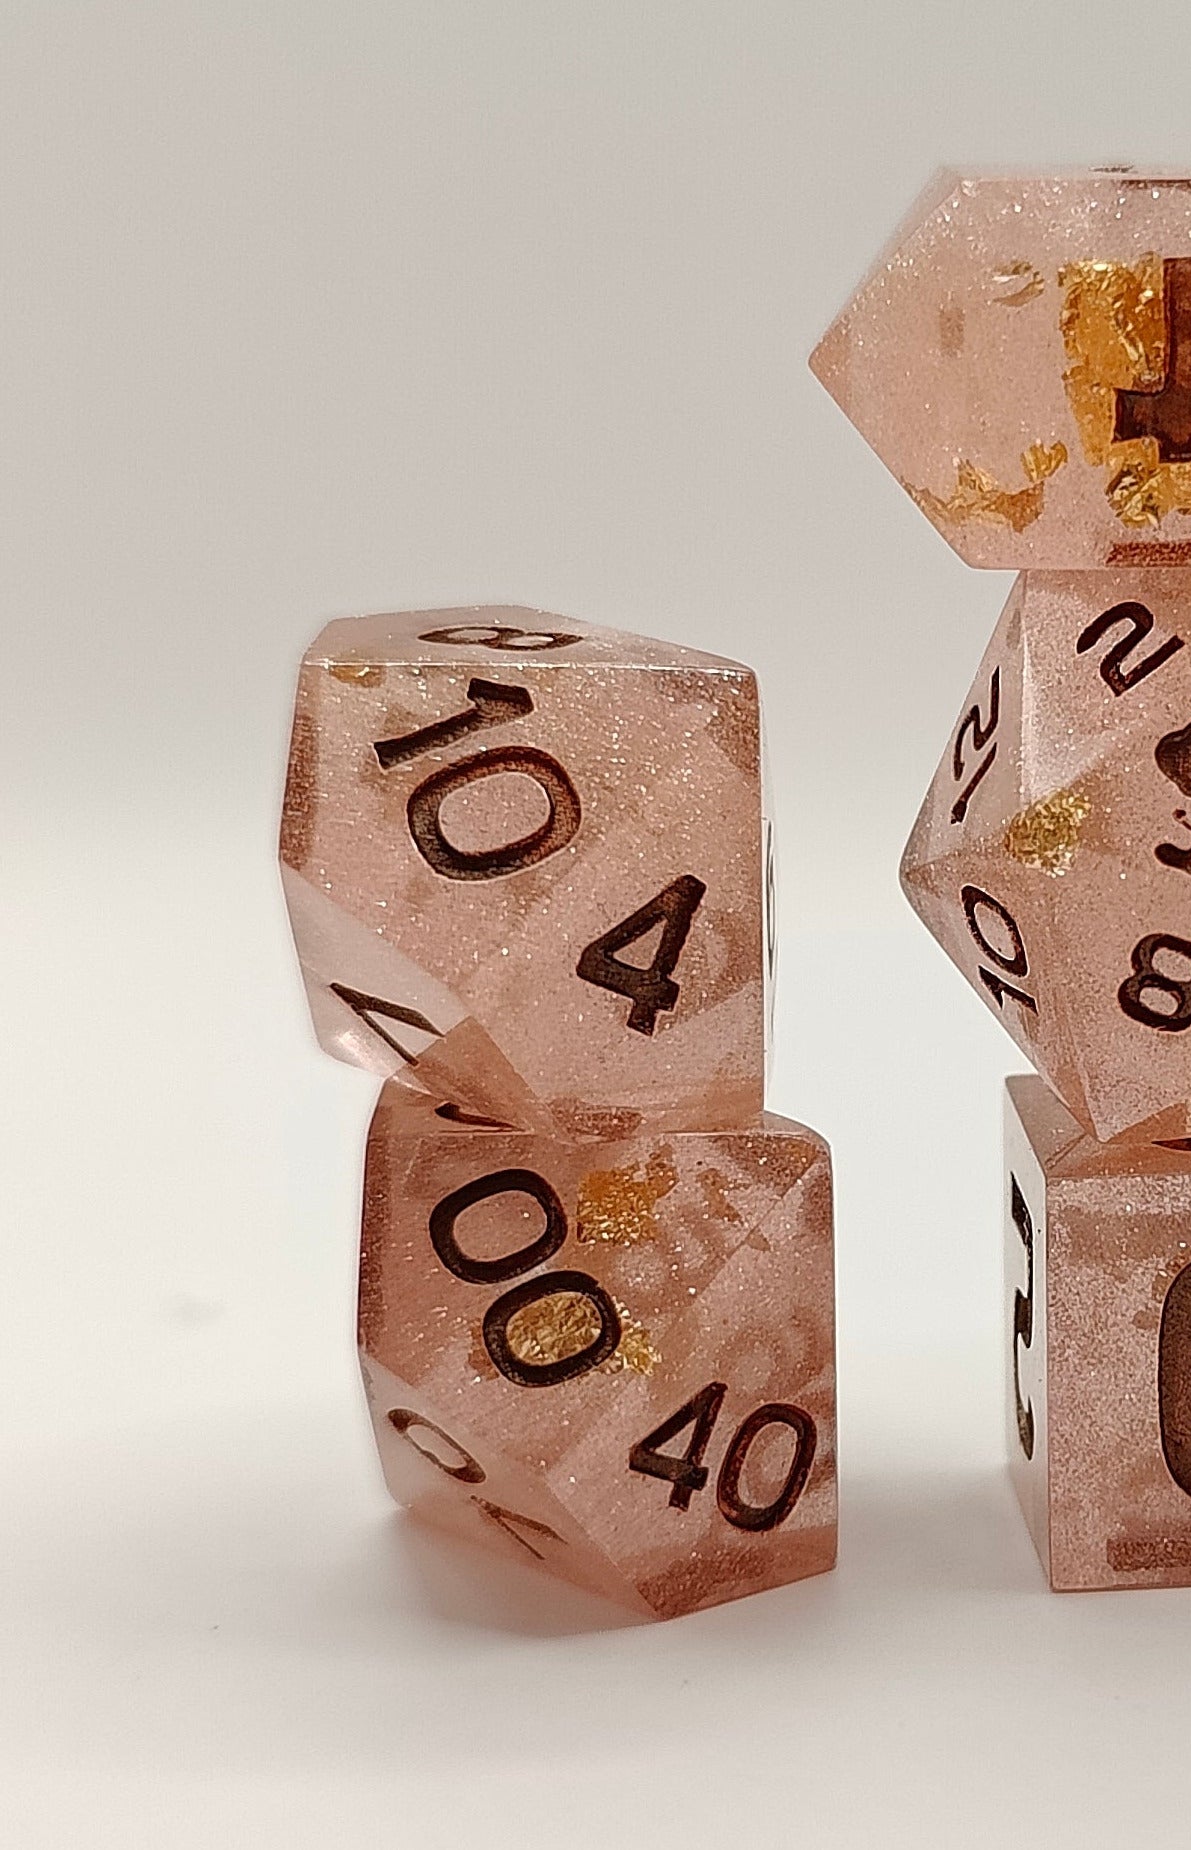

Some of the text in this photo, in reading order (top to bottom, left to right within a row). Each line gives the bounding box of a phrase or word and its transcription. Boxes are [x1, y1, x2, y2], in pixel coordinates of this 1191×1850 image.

[417, 625, 584, 651] 8
[1076, 601, 1186, 698] 2
[373, 677, 582, 882] 10
[950, 664, 1001, 825] 12
[575, 874, 707, 1037] 4
[960, 884, 1040, 1018] 10
[428, 1168, 623, 1388] 00
[628, 1380, 818, 1533] 40
